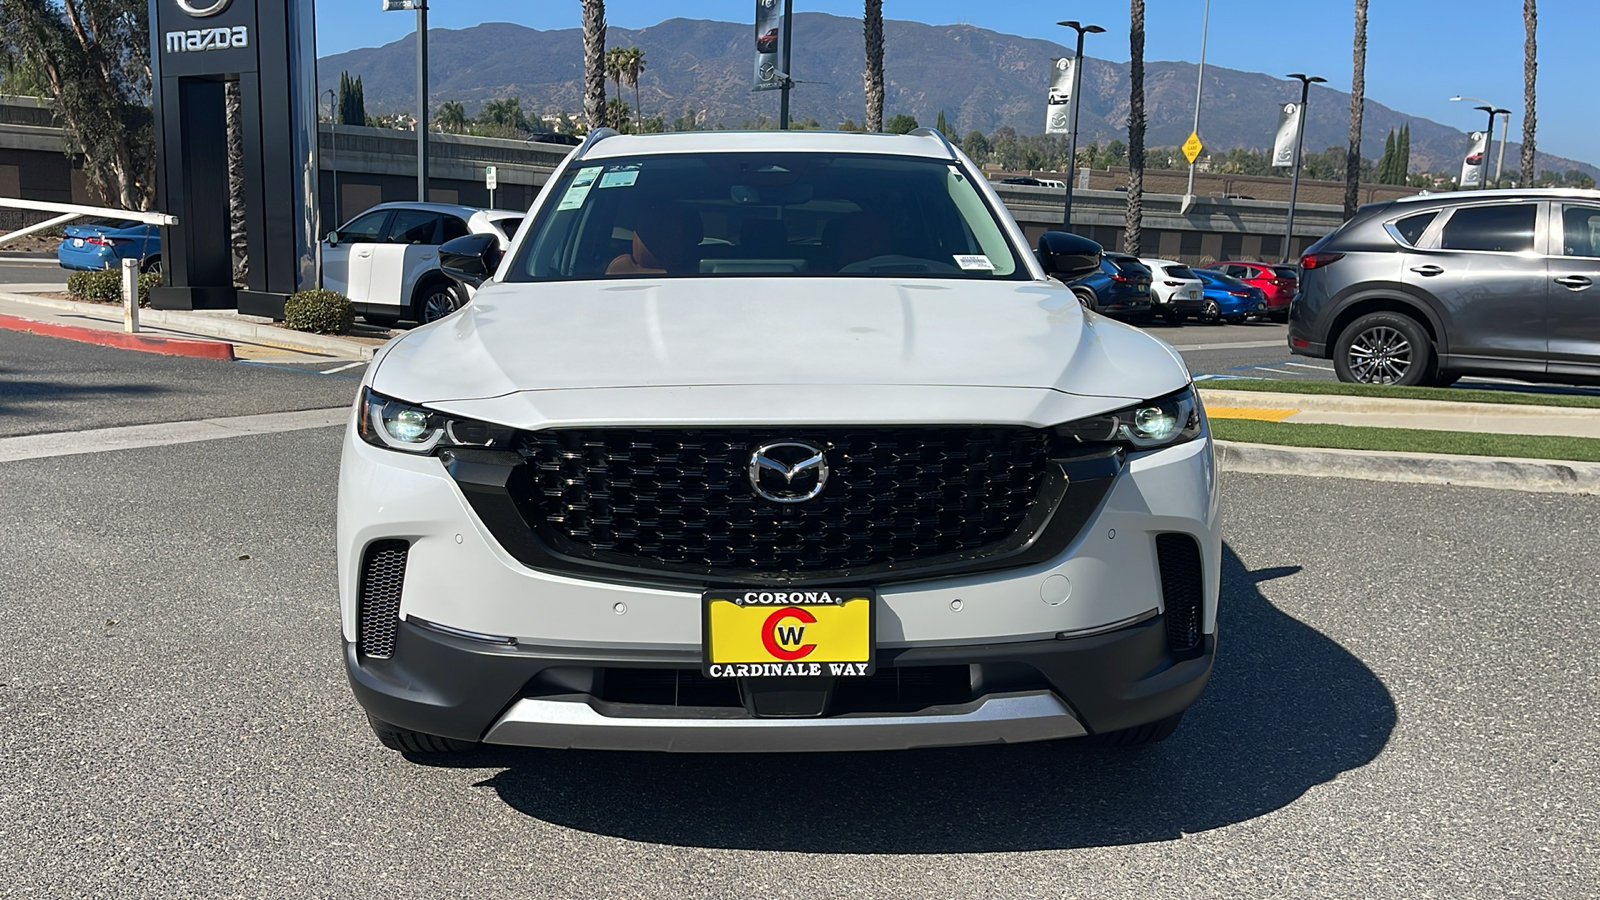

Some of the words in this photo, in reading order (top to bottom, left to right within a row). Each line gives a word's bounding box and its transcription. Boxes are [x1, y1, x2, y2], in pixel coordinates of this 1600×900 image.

[744, 592, 833, 604] CORONA
[761, 606, 818, 661] C
[778, 624, 806, 646] W
[709, 663, 822, 677] CARDINALE
[828, 663, 869, 676] WAY
